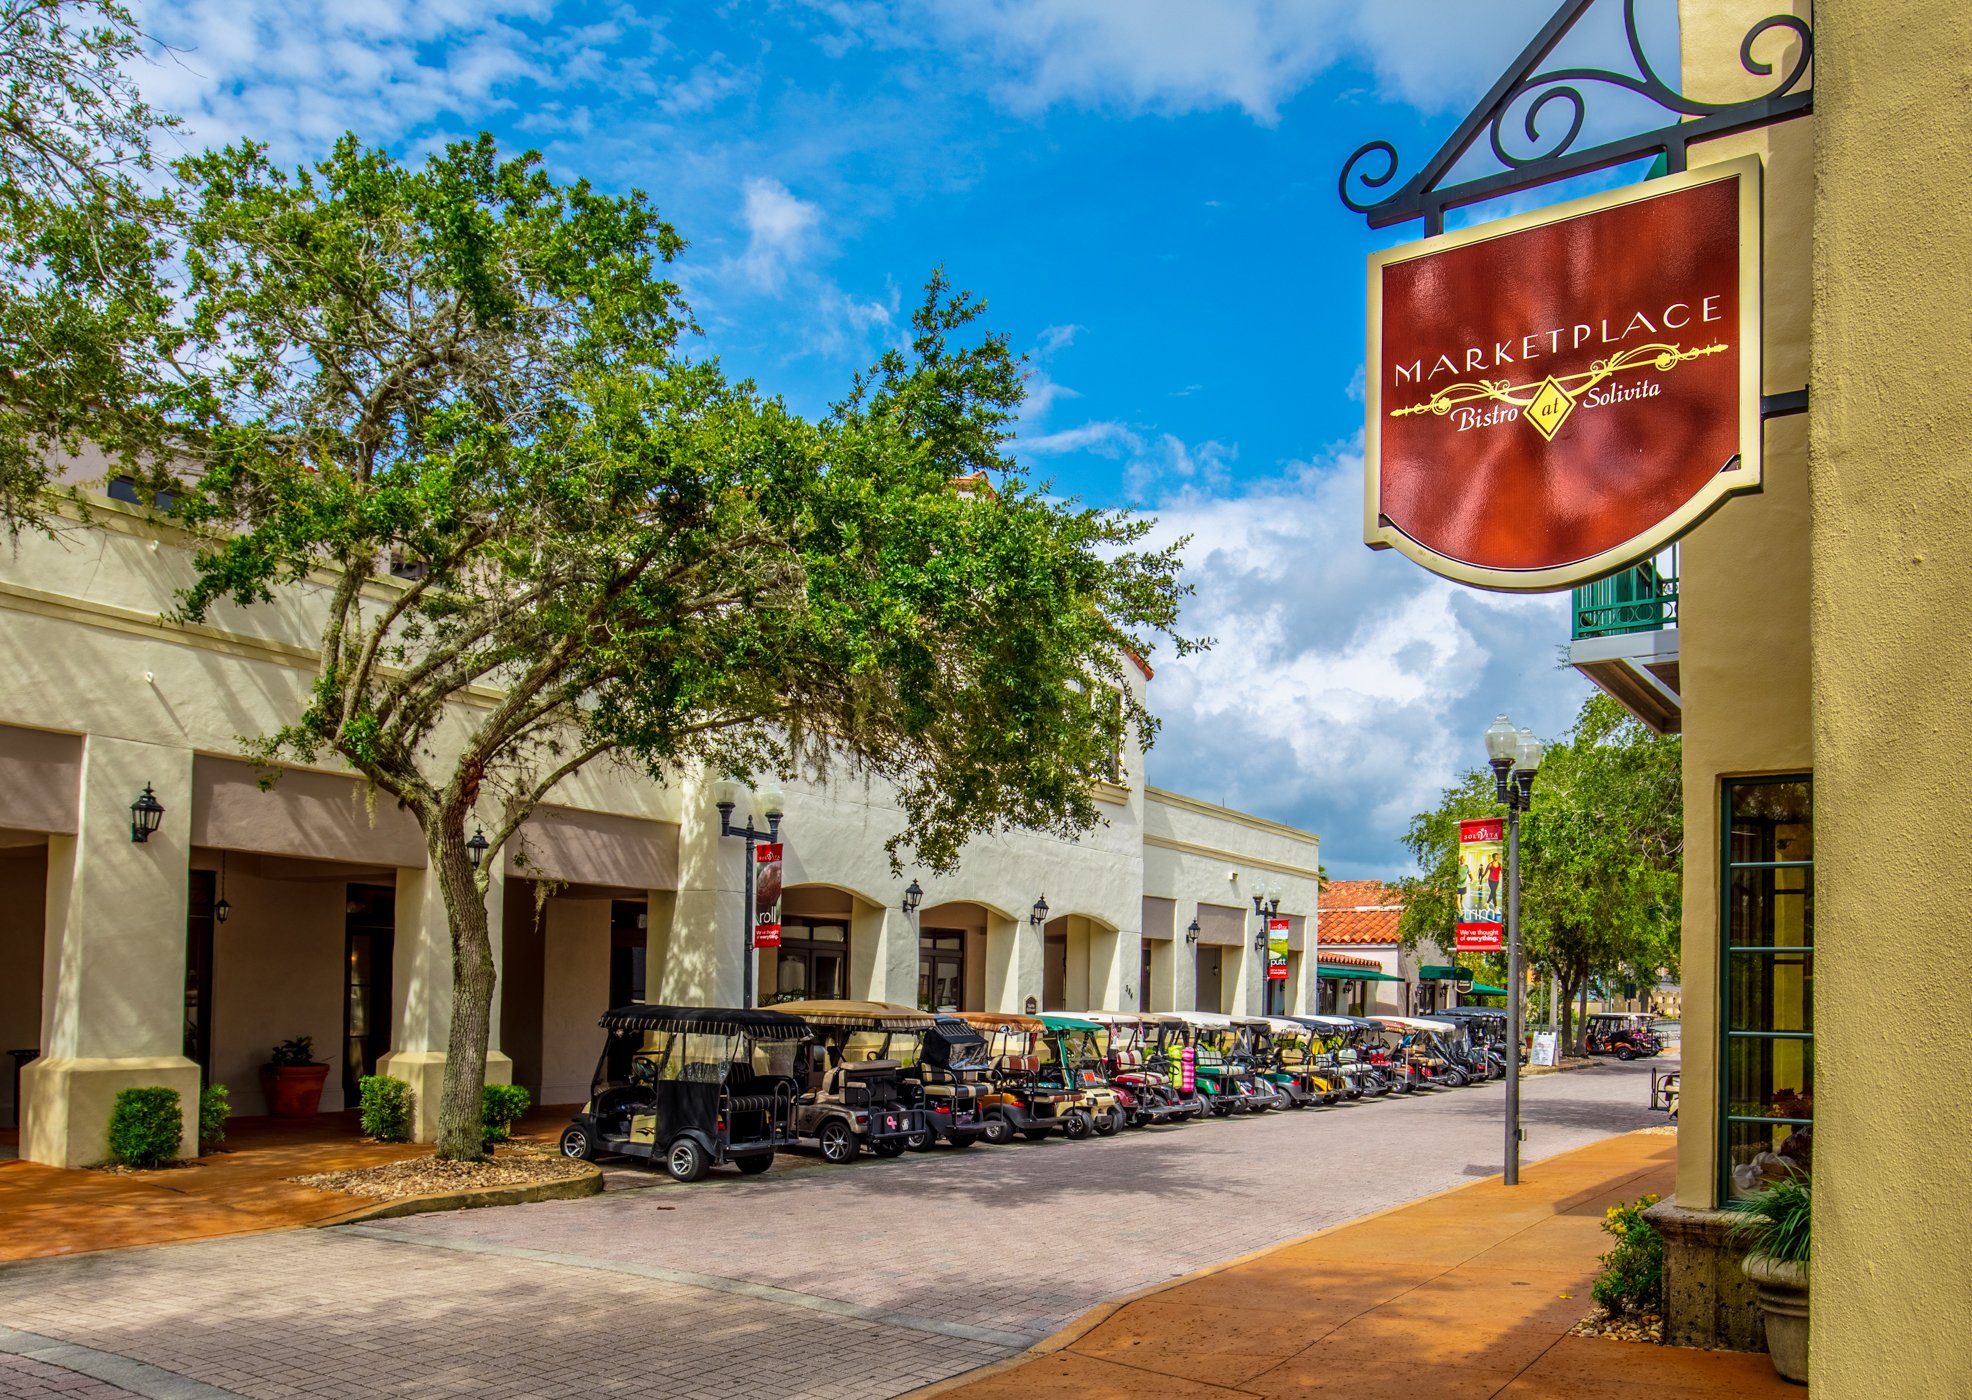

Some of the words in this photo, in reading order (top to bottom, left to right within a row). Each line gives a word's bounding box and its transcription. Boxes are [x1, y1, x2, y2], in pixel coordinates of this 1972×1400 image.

[1395, 295, 1722, 387] MARKETPLACE
[1450, 404, 1519, 432] Bistro
[1541, 397, 1560, 417] at
[1582, 379, 1661, 409] Solivita
[759, 905, 776, 924] roll
[1460, 934, 1466, 942] of
[1477, 929, 1499, 937] thought
[1271, 958, 1286, 967] putt
